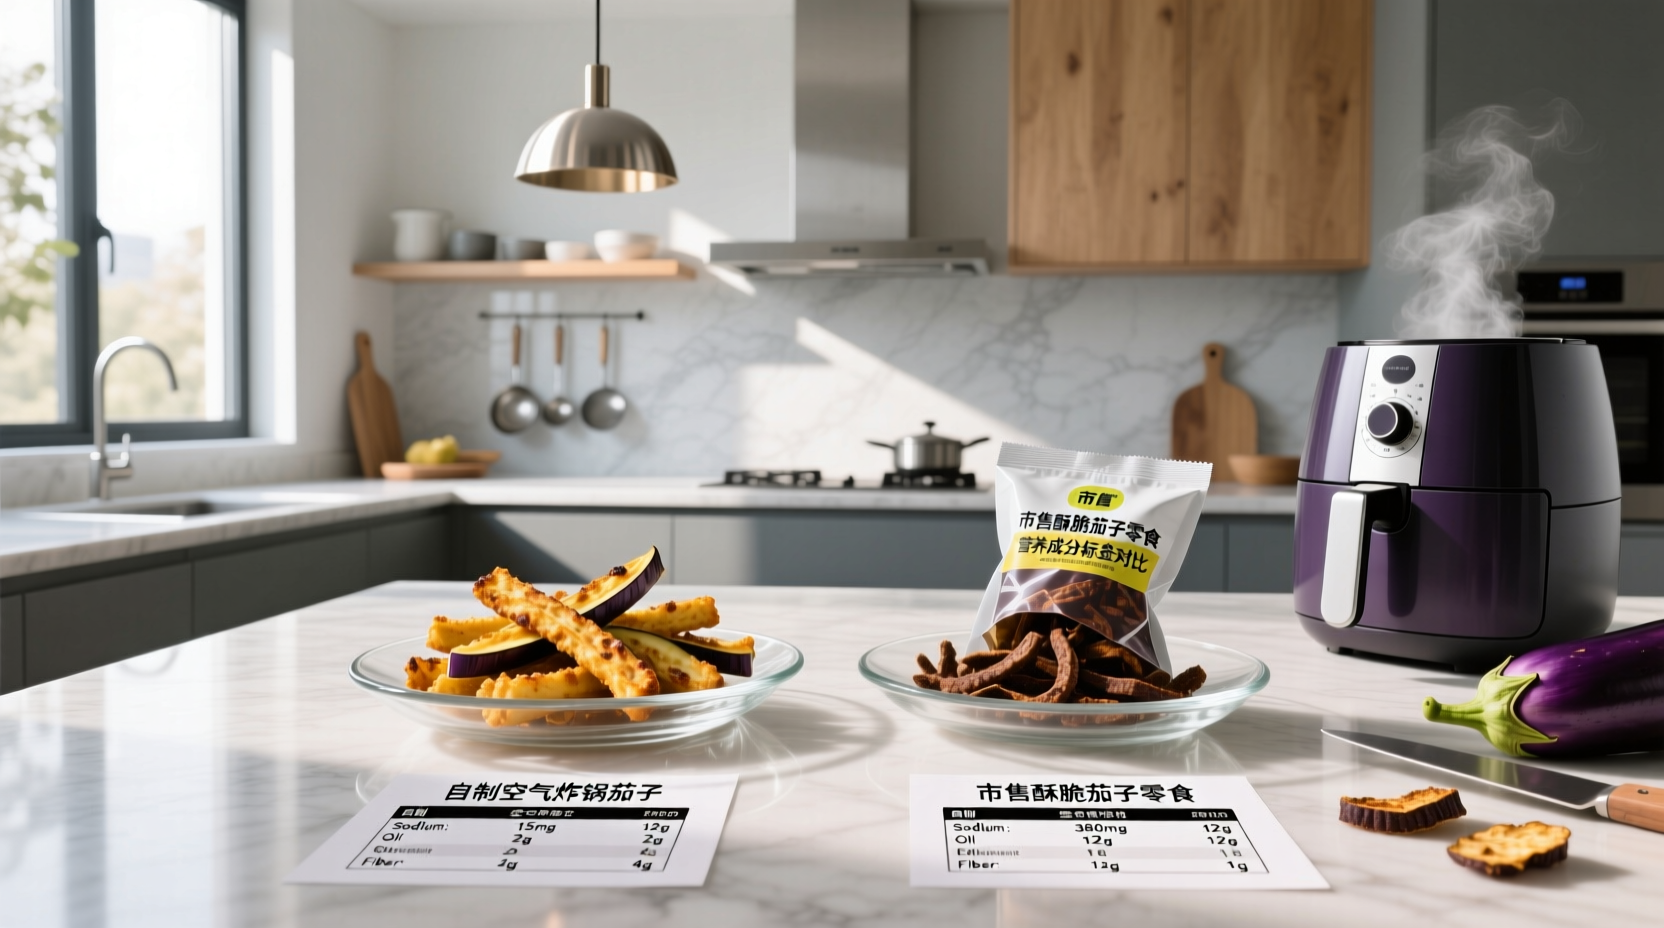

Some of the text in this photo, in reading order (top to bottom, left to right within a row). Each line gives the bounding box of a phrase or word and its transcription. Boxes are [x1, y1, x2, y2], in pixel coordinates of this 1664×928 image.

[445, 782, 662, 802] 自制空气炸锅茄子
[976, 782, 1195, 803] 市售酥脆茄子零食
[518, 821, 556, 834] 15mg
[1075, 823, 1127, 835] 380mg
